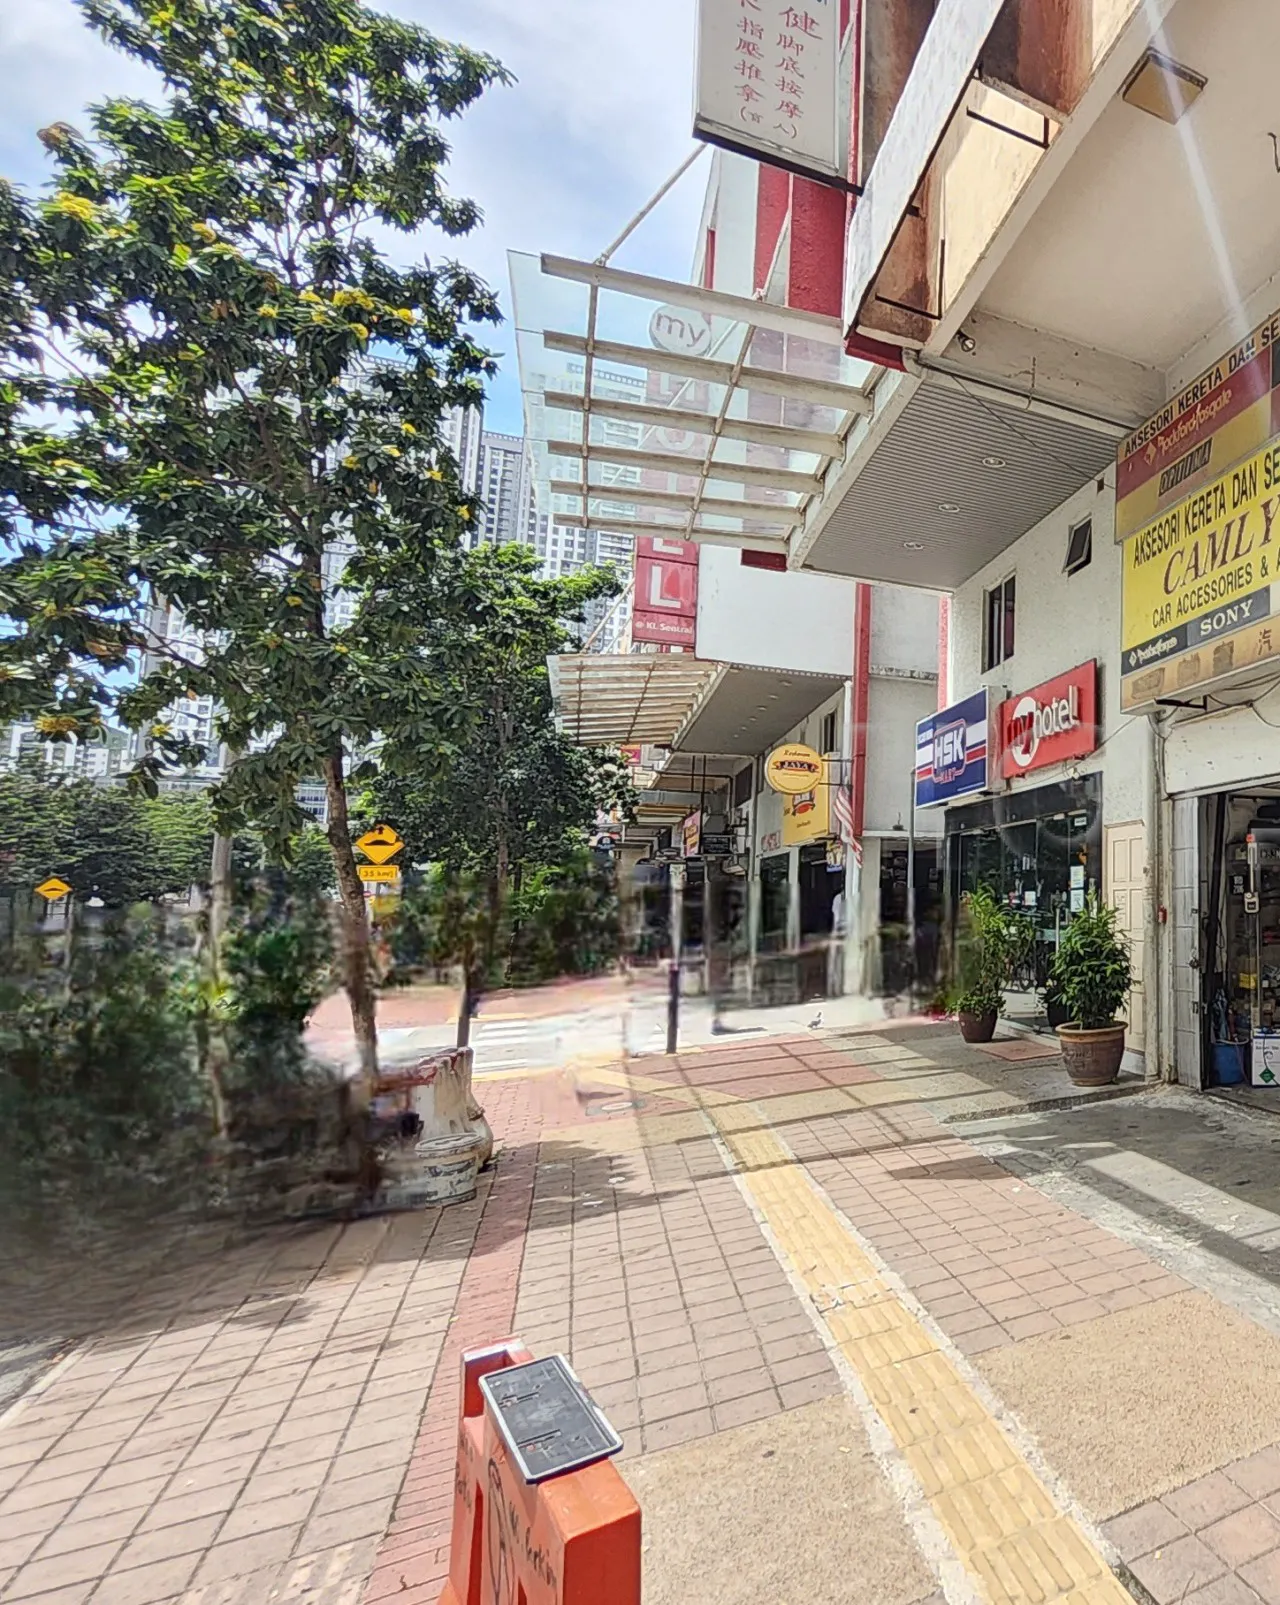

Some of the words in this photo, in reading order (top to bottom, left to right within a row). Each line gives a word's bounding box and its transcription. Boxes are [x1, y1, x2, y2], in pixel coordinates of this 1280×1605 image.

[1124, 406, 1174, 457] AKSESORI
[1178, 366, 1223, 415] KERETA
[1133, 509, 1181, 568] AKSESORI
[1185, 481, 1227, 535] KERETA
[1232, 460, 1257, 509] DAN
[1152, 602, 1173, 628] CAR
[1176, 562, 1253, 619] ACCESSORIES
[1260, 554, 1269, 578] &
[1200, 599, 1254, 636] SONY
[934, 726, 965, 770] HSK
